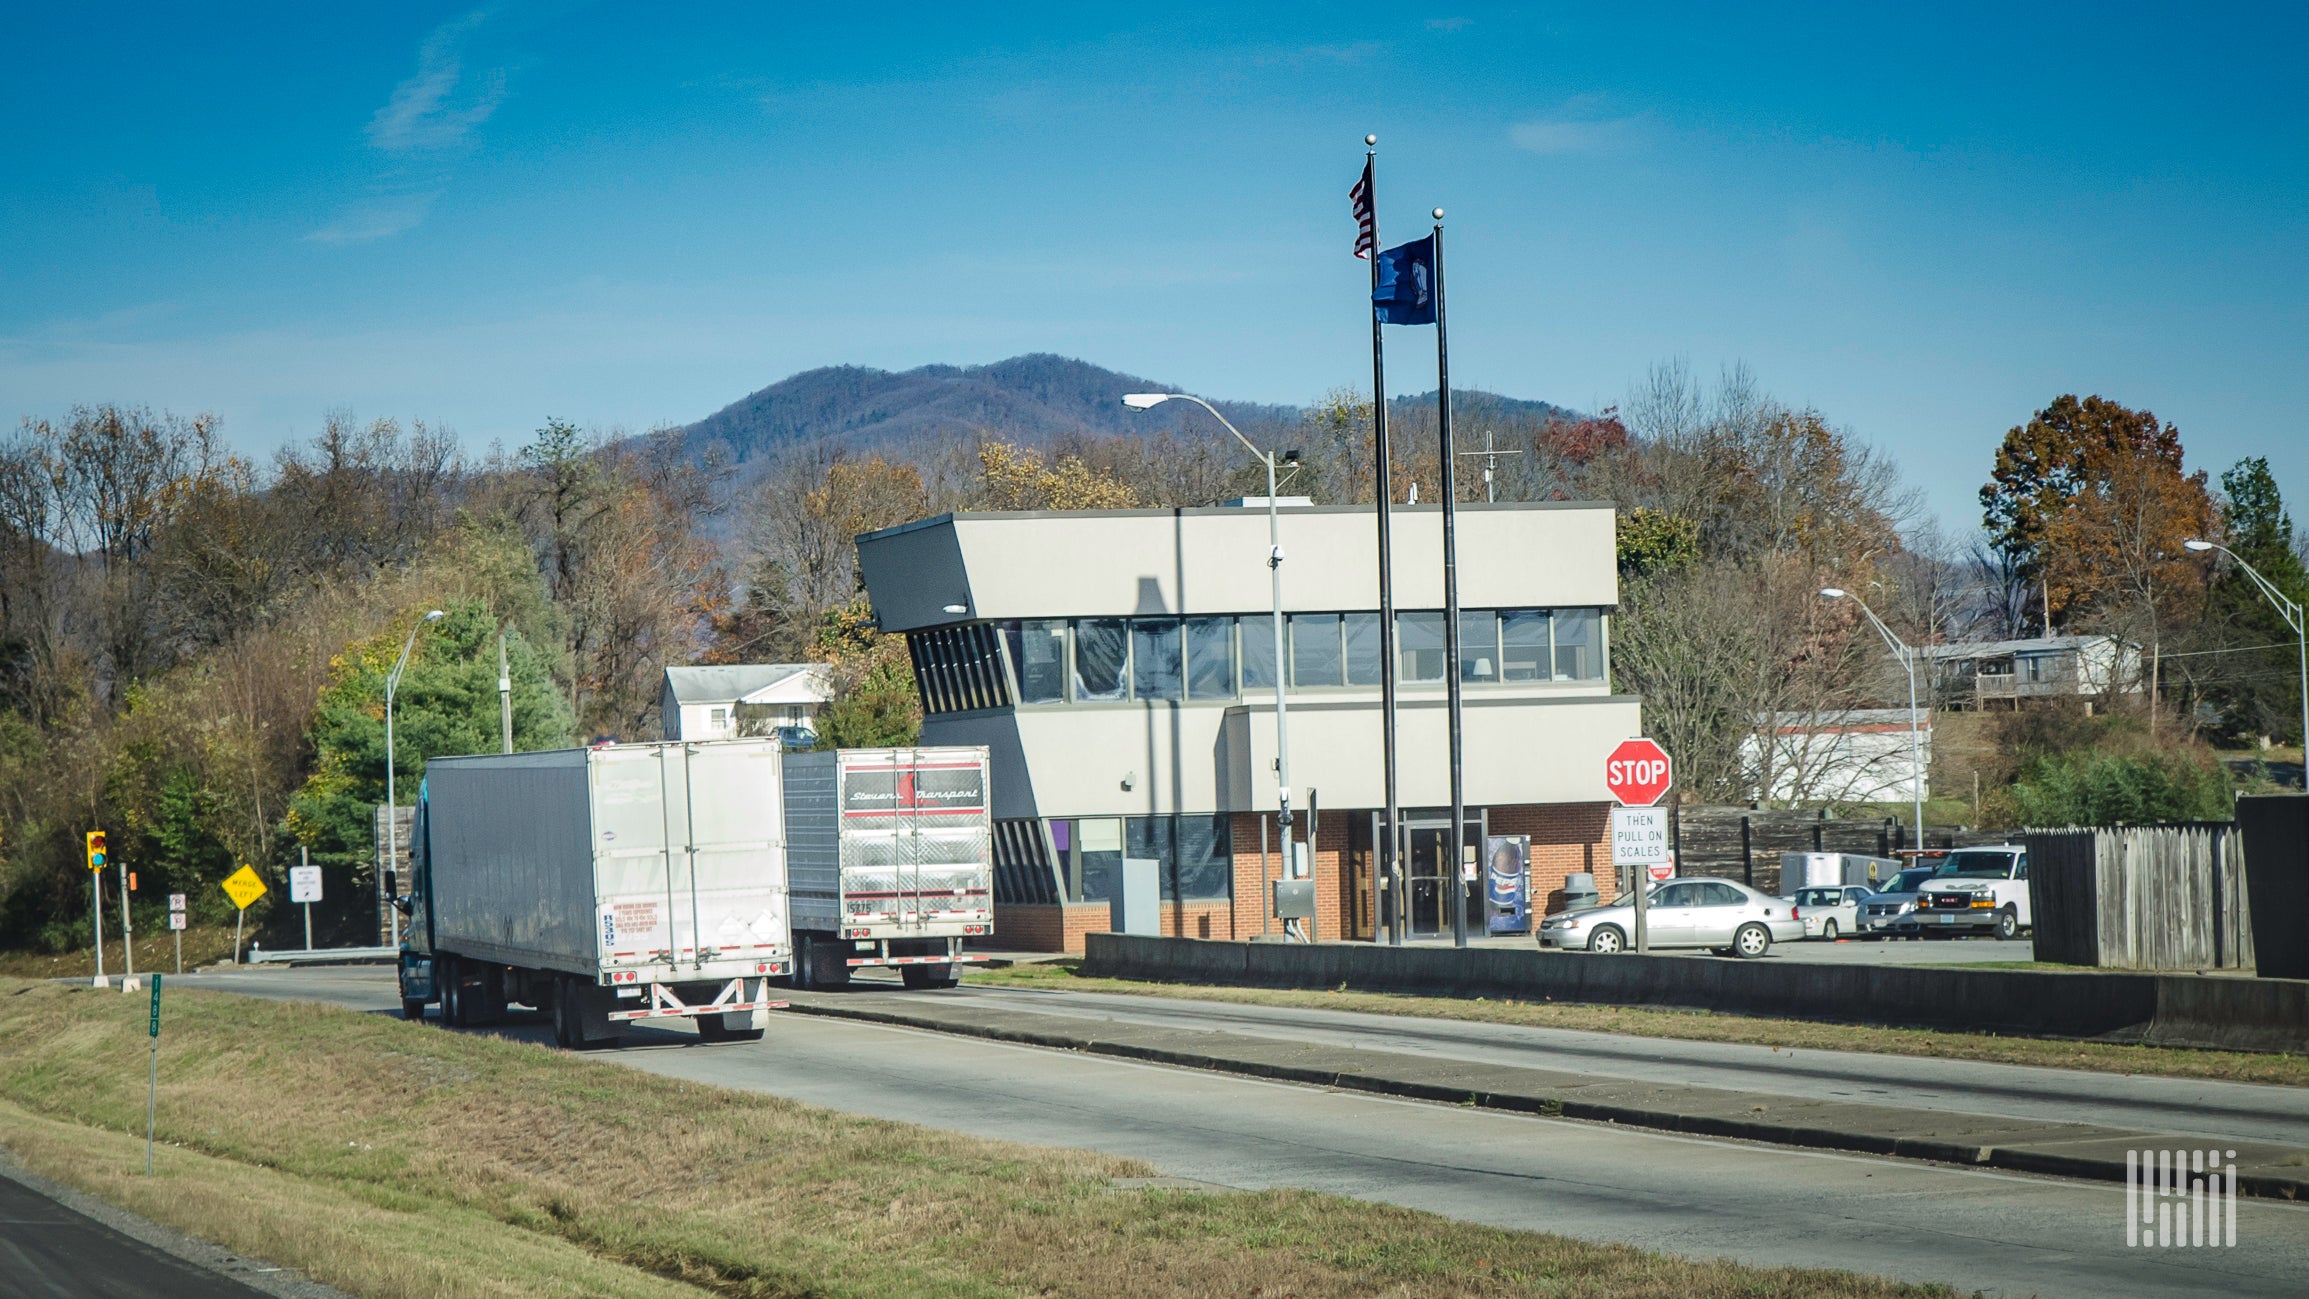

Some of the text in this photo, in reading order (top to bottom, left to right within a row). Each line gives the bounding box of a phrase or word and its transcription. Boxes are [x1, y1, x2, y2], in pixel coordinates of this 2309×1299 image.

[1609, 760, 1666, 785] STOP
[916, 789, 977, 800] Transport
[1627, 815, 1653, 826] THEN
[1618, 831, 1662, 841] PULL ON
[1620, 846, 1660, 857] SCALES
[232, 880, 257, 888] MERGE
